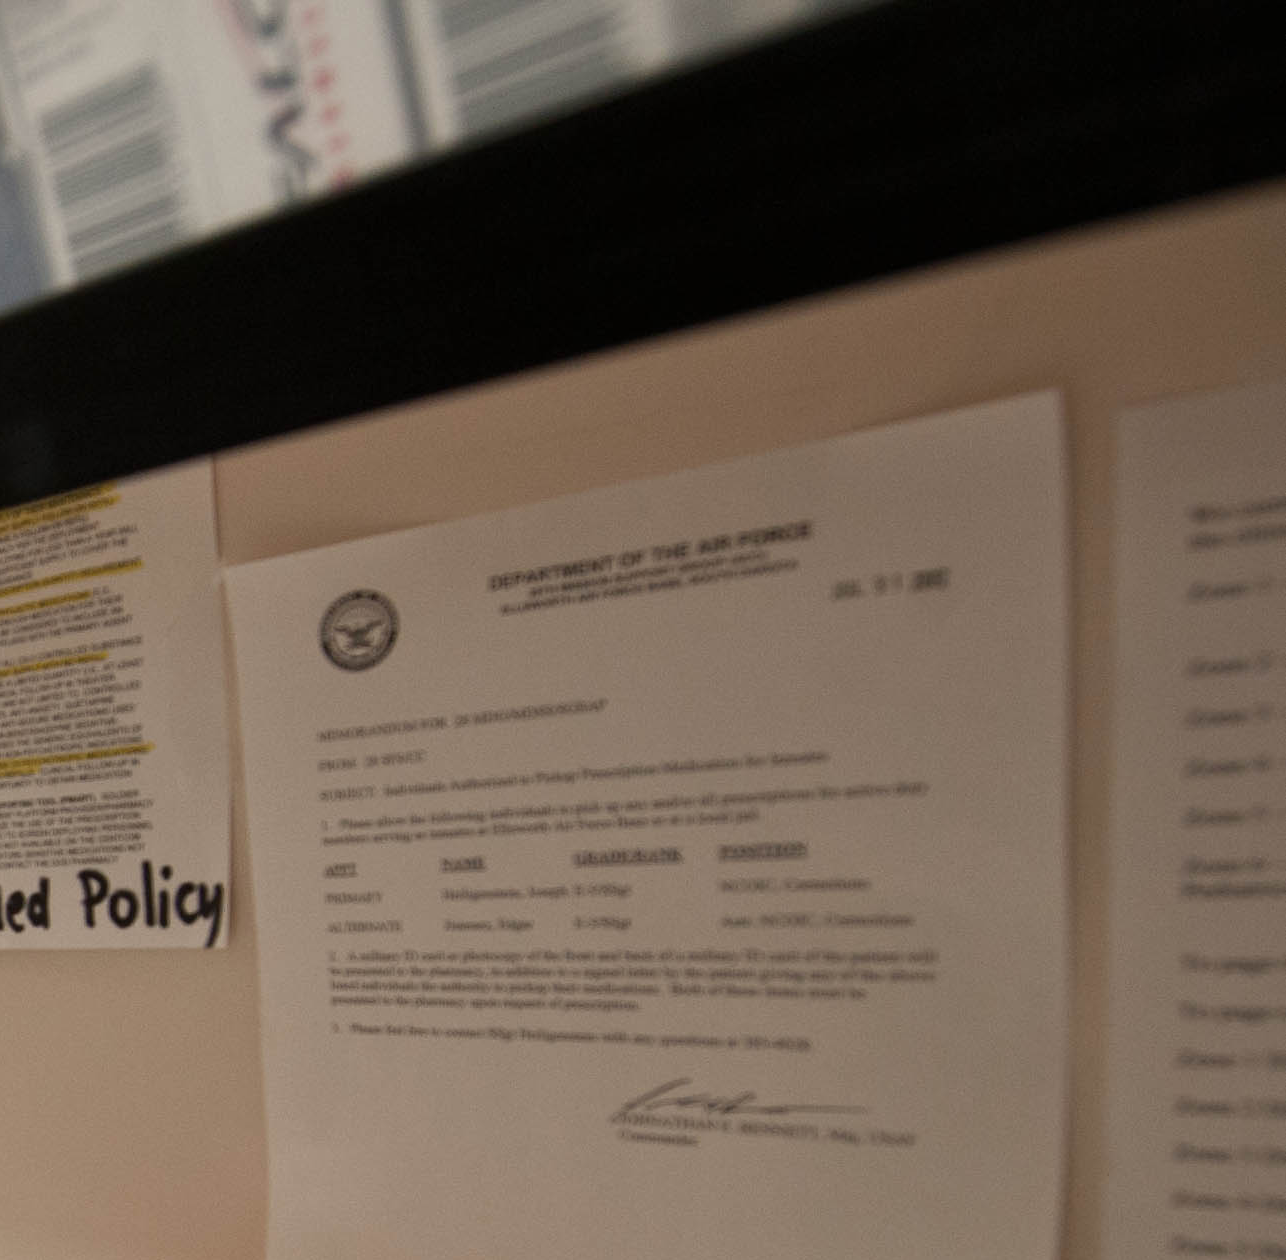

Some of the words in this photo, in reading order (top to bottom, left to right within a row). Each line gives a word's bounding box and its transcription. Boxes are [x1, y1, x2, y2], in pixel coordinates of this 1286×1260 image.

[487, 553, 614, 592] DEPARTMENT
[618, 548, 645, 568] OF
[651, 540, 691, 561] THE
[697, 534, 730, 554] AIR
[736, 519, 813, 547] FORCE
[77, 860, 226, 949] Policy
